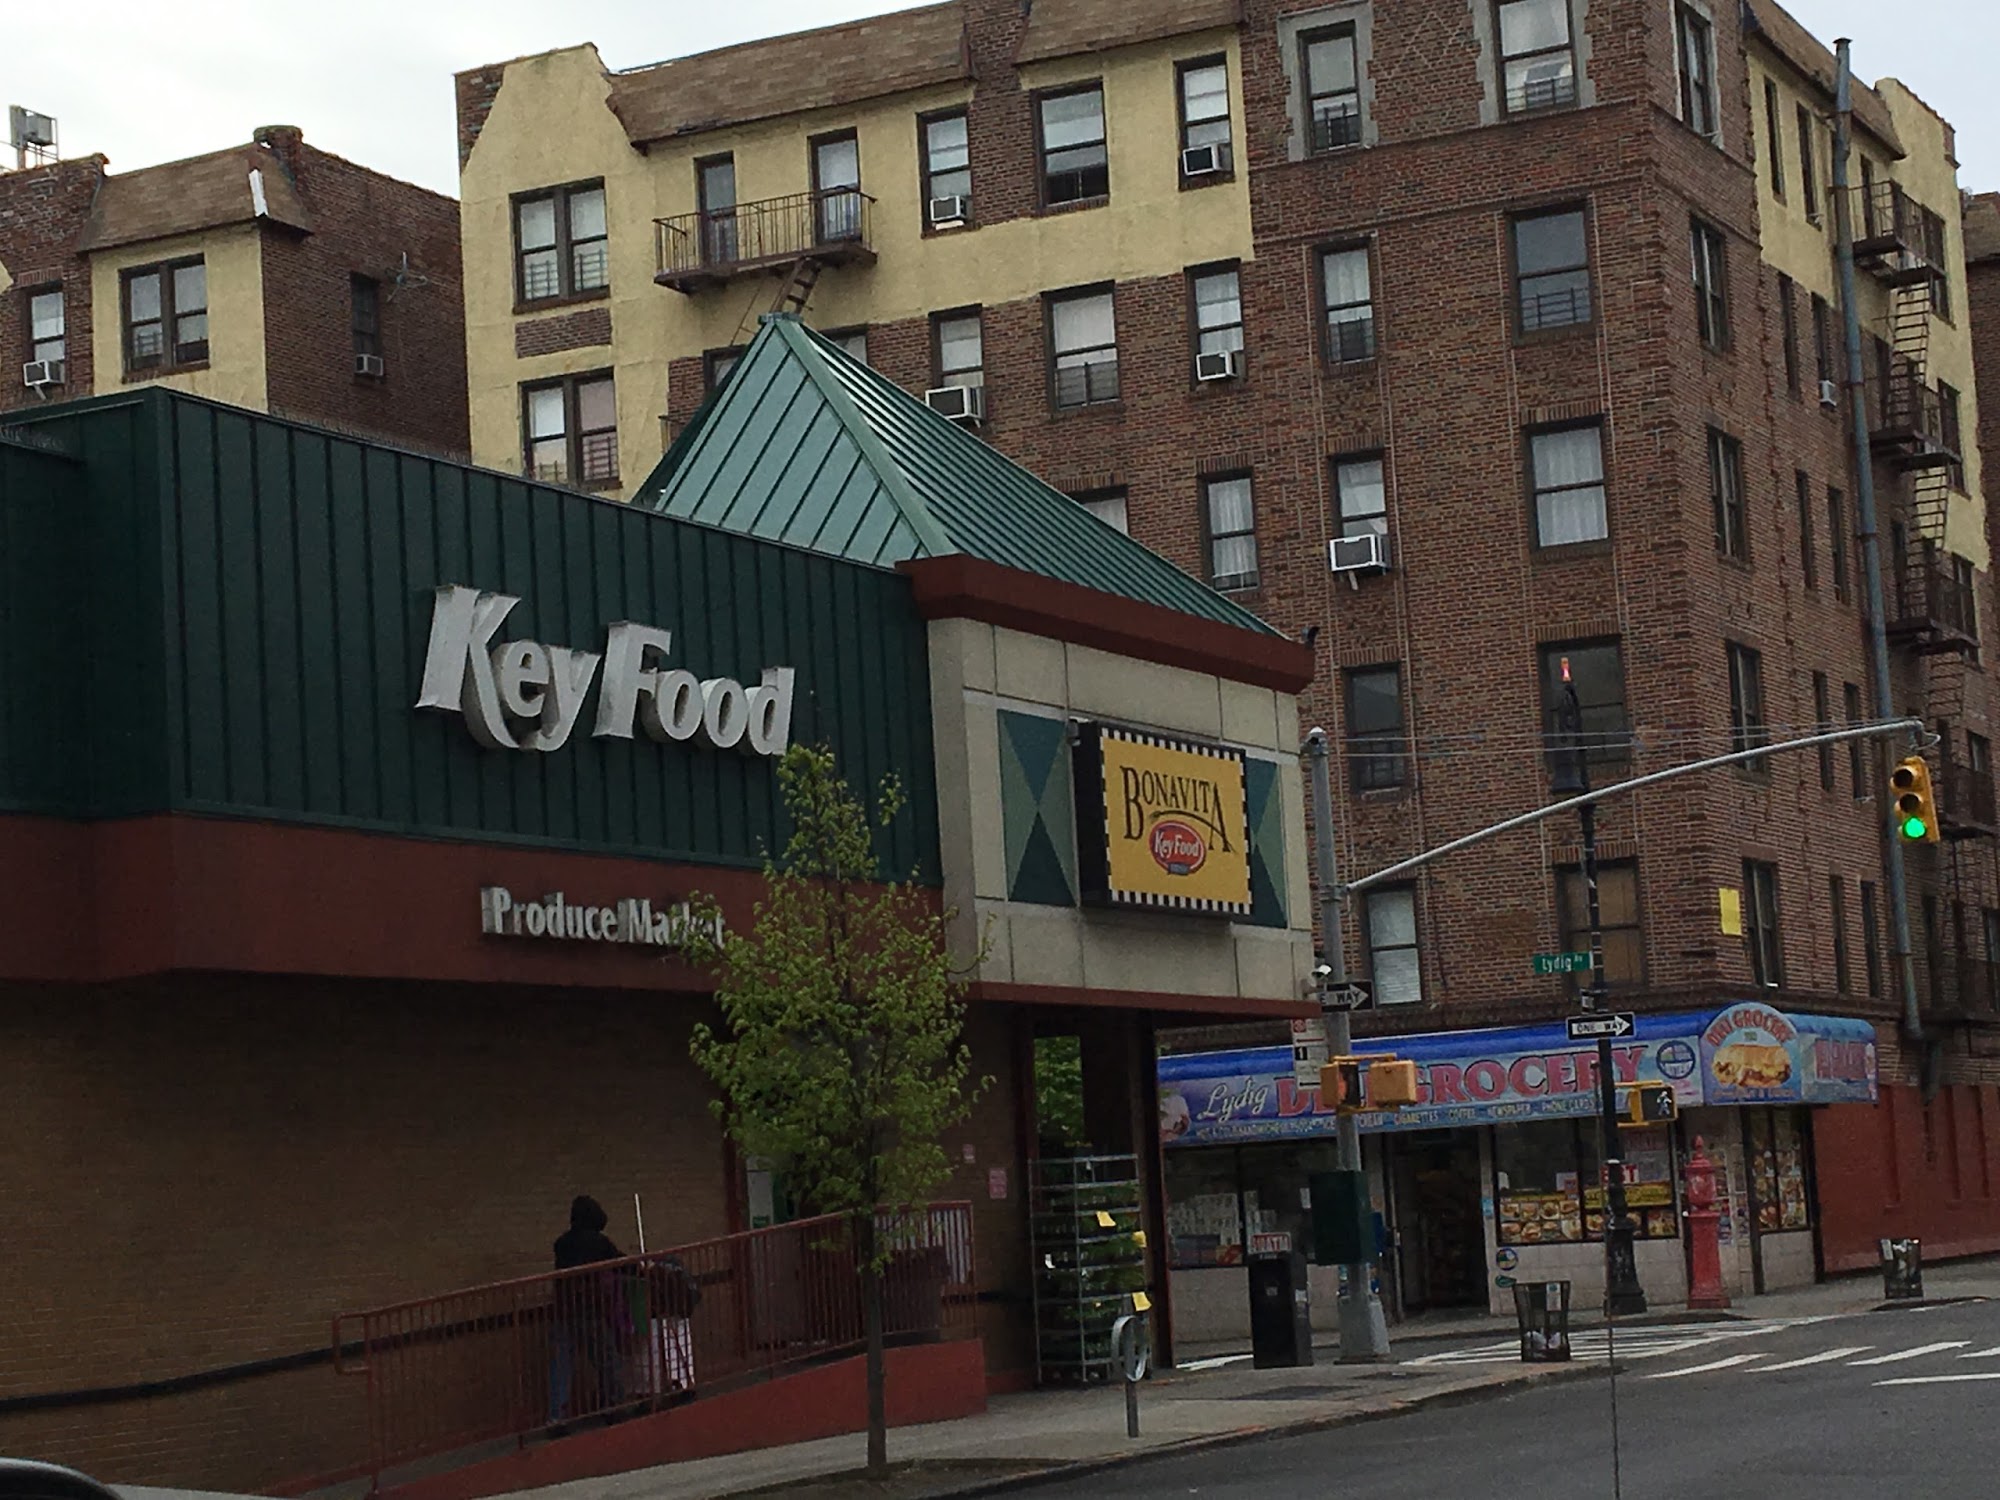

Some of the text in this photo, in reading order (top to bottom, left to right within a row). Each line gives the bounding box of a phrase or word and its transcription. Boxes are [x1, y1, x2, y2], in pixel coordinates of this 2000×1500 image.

[414, 583, 795, 756] Key Food
[1120, 765, 1231, 852] BONAVITA
[1155, 830, 1199, 859] Key Food
[481, 886, 618, 941] Produce
[1541, 956, 1572, 973] Lydig
[1336, 990, 1361, 1003] WAY
[1577, 1021, 1623, 1034] ONE WAY
[1197, 1077, 1269, 1123] Lydig
